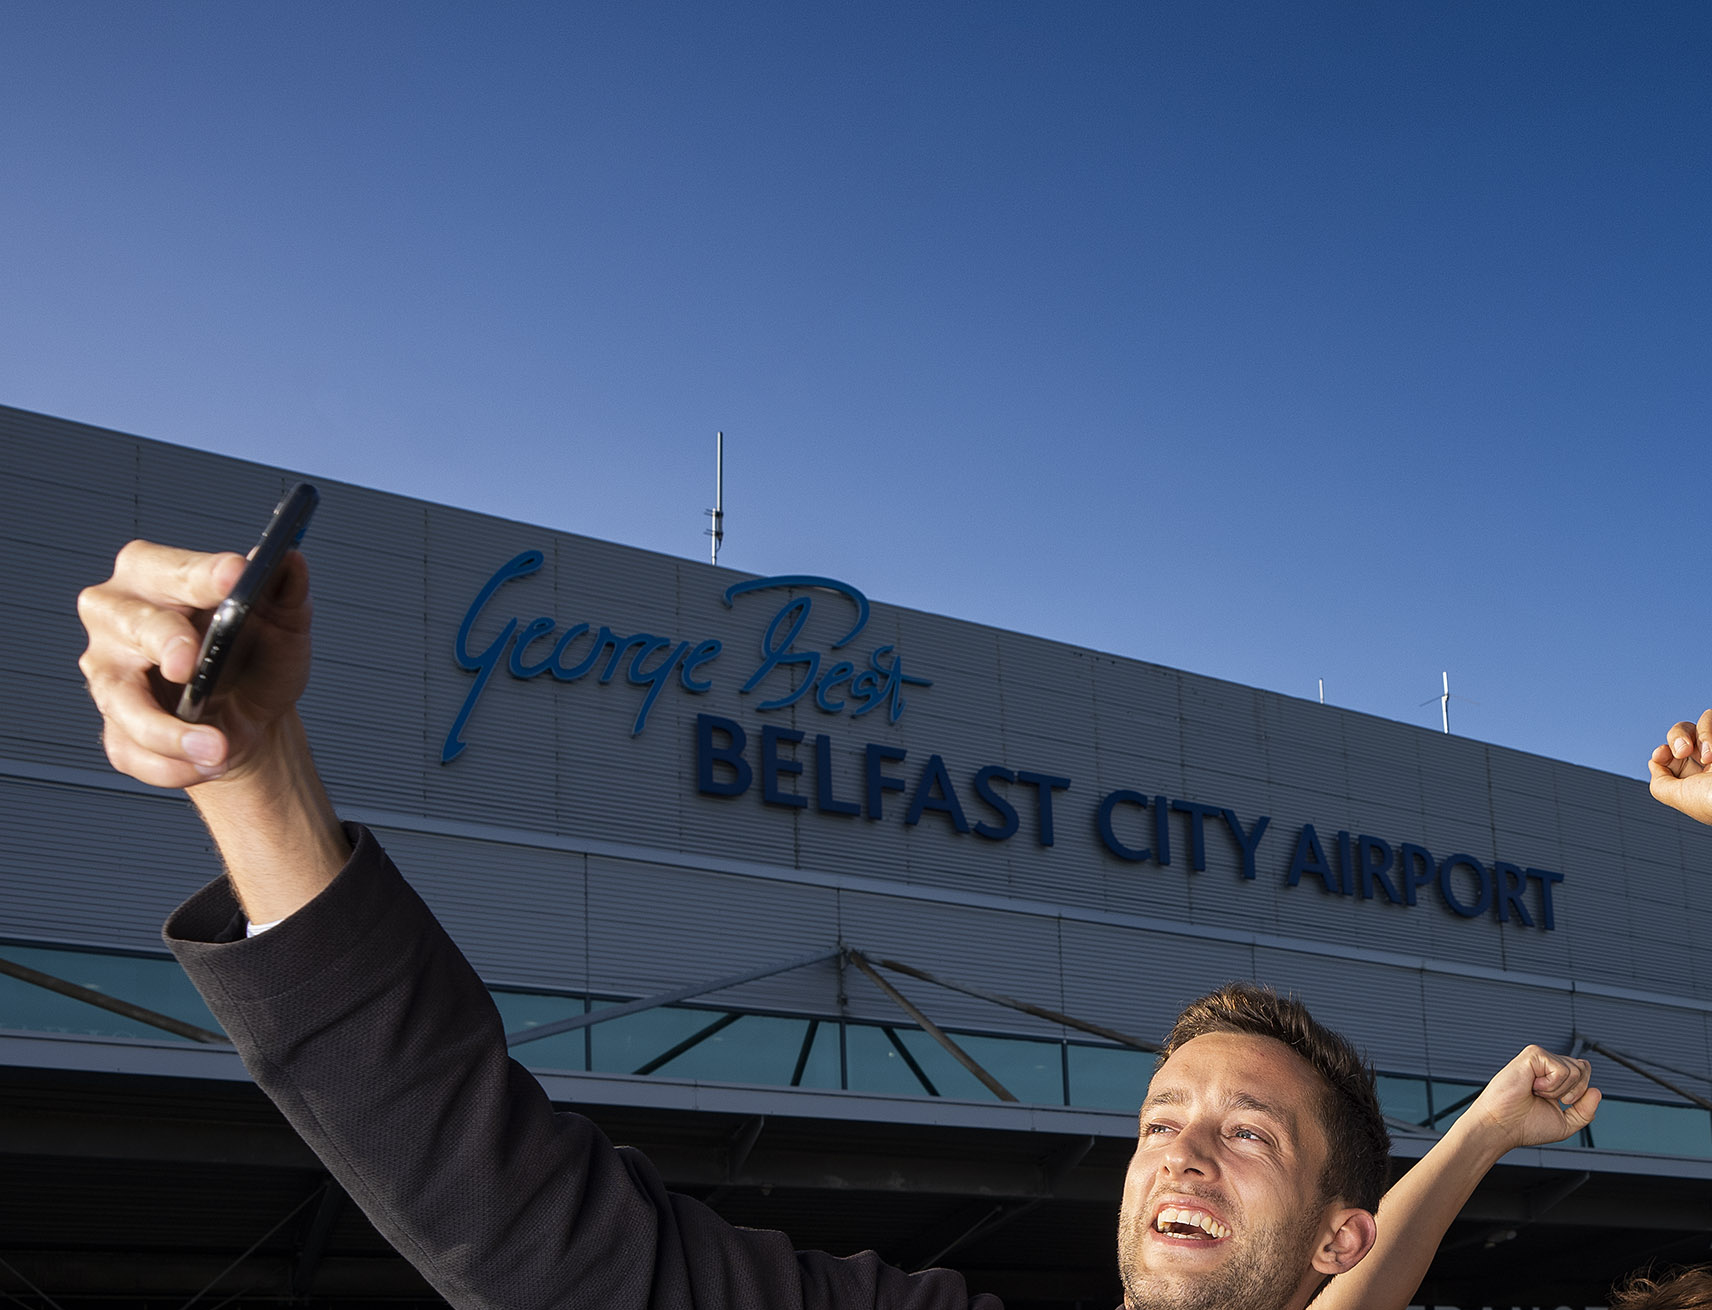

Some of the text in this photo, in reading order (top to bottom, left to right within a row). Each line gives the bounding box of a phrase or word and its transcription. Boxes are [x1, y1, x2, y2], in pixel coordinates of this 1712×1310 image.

[442, 550, 933, 764] George Best
[697, 713, 1564, 931] BELFAST CITY AIRPORT
